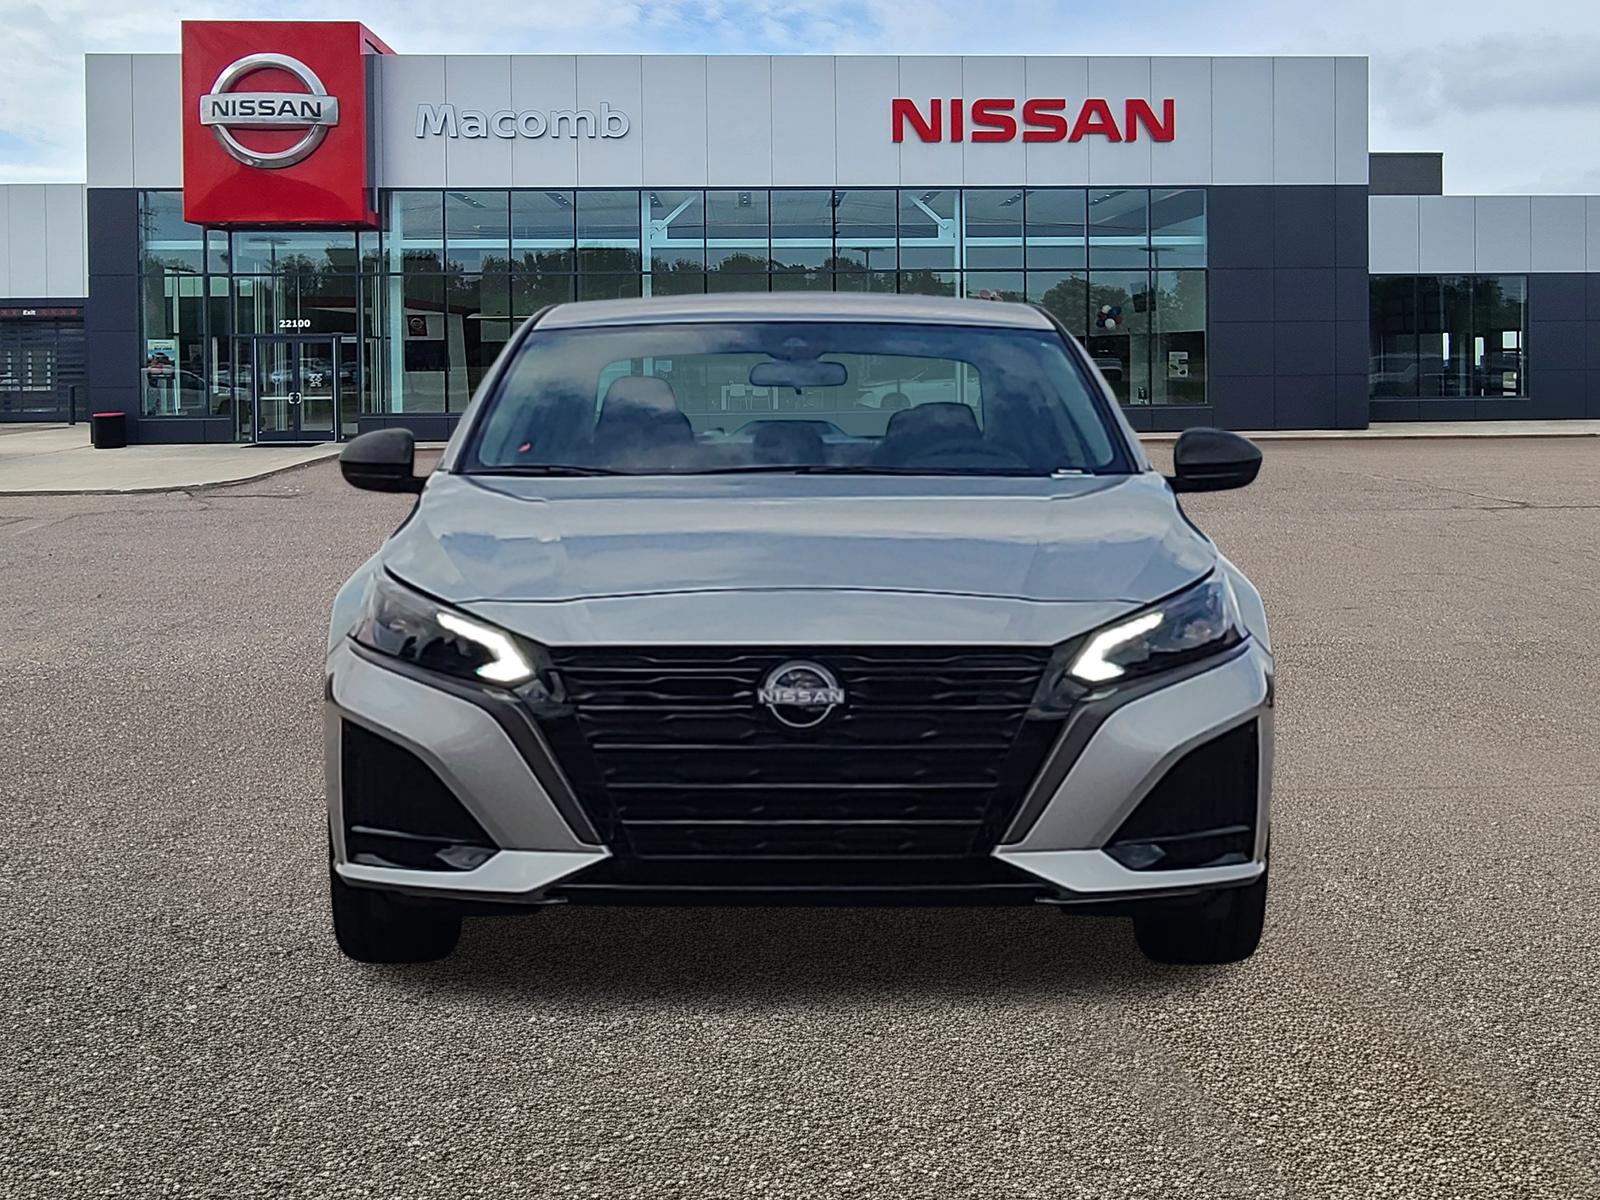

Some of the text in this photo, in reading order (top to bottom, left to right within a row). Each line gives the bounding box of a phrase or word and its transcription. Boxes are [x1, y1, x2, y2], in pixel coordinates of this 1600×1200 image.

[212, 100, 322, 118] NISSAN
[415, 102, 630, 139] Macomb
[891, 98, 1175, 143] NISSAN
[279, 319, 311, 328] 22100
[758, 688, 845, 704] NISSAN
